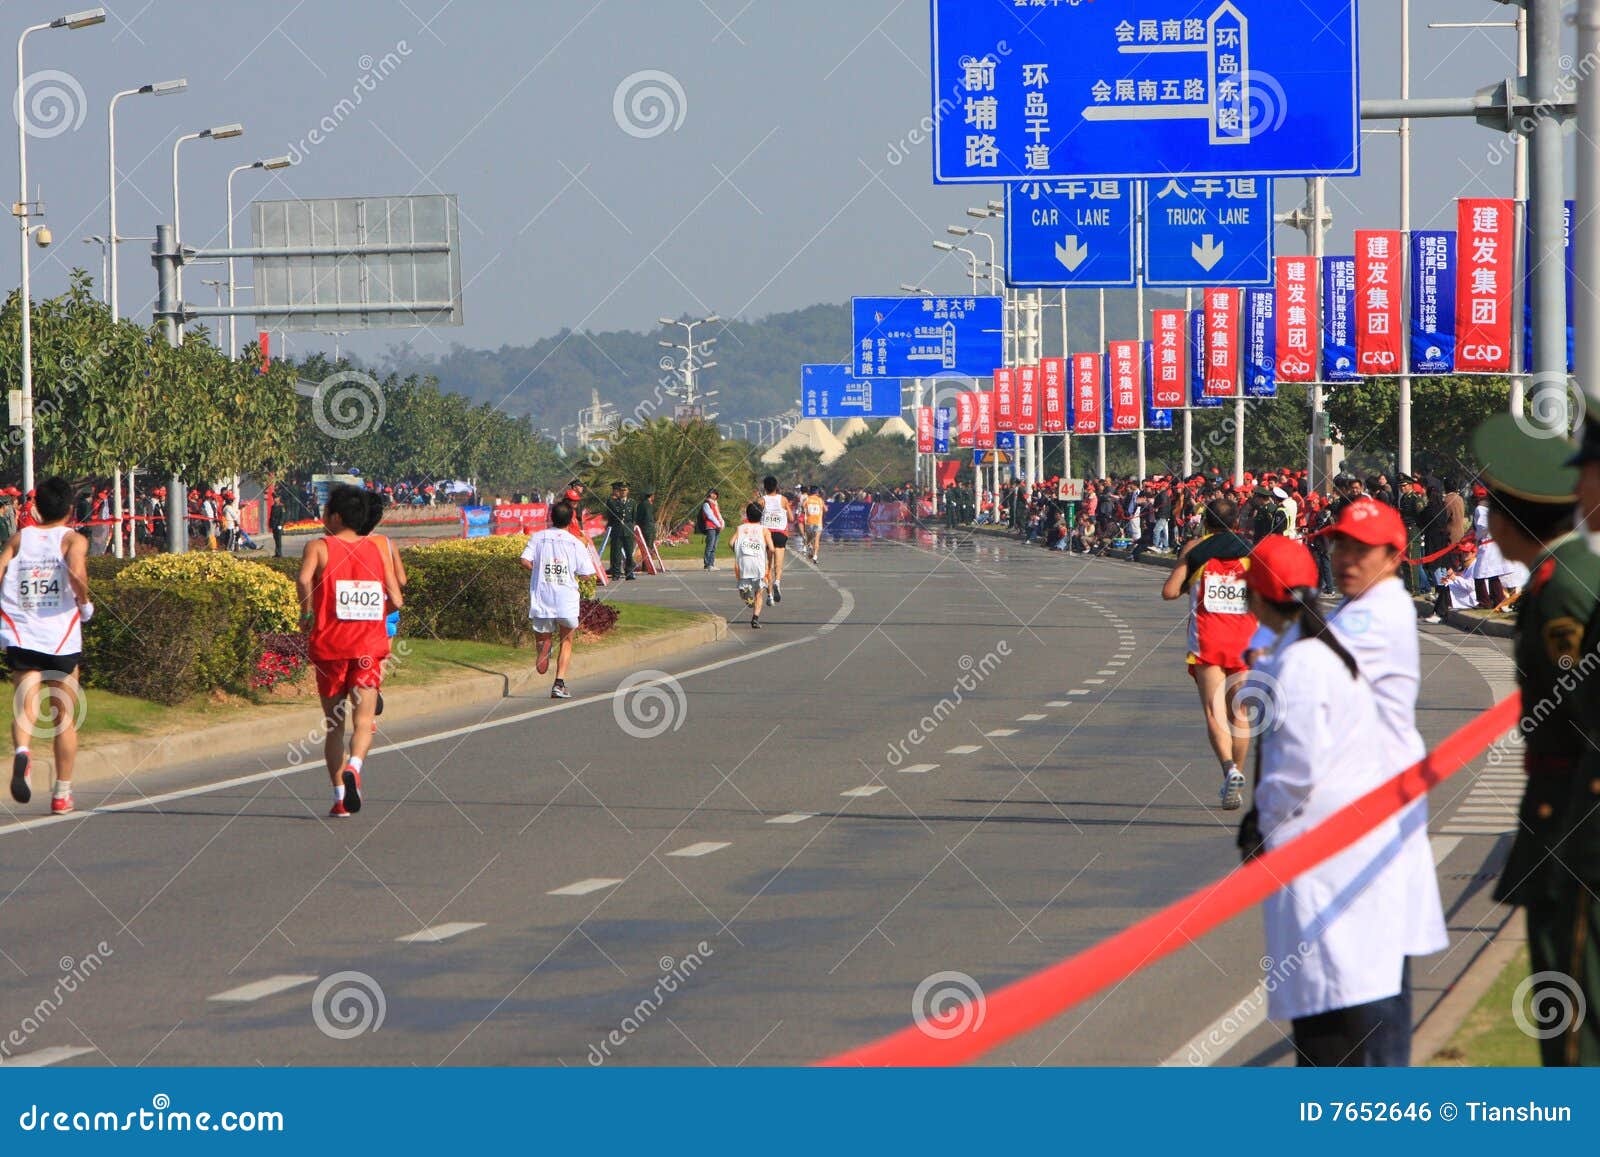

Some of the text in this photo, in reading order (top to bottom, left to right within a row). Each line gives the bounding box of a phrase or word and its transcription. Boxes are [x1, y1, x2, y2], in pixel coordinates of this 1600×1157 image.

[1114, 19, 1205, 42] 会展南路
[1091, 79, 1205, 102] 会展南五路
[1216, 28, 1240, 130] 环岛东路
[963, 57, 1000, 167] 前埔路
[1022, 63, 1050, 170] 环岛干道
[1031, 208, 1110, 226] CAR LANE
[1167, 207, 1250, 225] TRUCK LANE
[1436, 236, 1447, 270] 2009
[1346, 261, 1355, 291] 2009
[1472, 207, 1498, 324] 建发集团
[1367, 237, 1389, 334] 建发集团
[1425, 236, 1436, 334] 建发厦门国际马拉松赛
[922, 299, 976, 311] 集美大桥
[1287, 262, 1307, 348] 建发集团
[1212, 293, 1229, 366] 建发集团
[1161, 314, 1176, 381] 建发集团
[1362, 352, 1395, 365] C&D
[1463, 344, 1502, 361] C&D
[1117, 345, 1133, 405] 建发集团
[1281, 362, 1310, 374] C&D
[1045, 361, 1058, 412] 建发集团
[1080, 356, 1093, 412] 建发集团
[1207, 378, 1231, 389] C&D
[1157, 391, 1180, 402] C&D
[1117, 416, 1136, 424] C&D
[1061, 483, 1075, 496] 41
[20, 579, 59, 595] 5154
[340, 591, 380, 606] 0402
[1208, 585, 1248, 600] 5684
